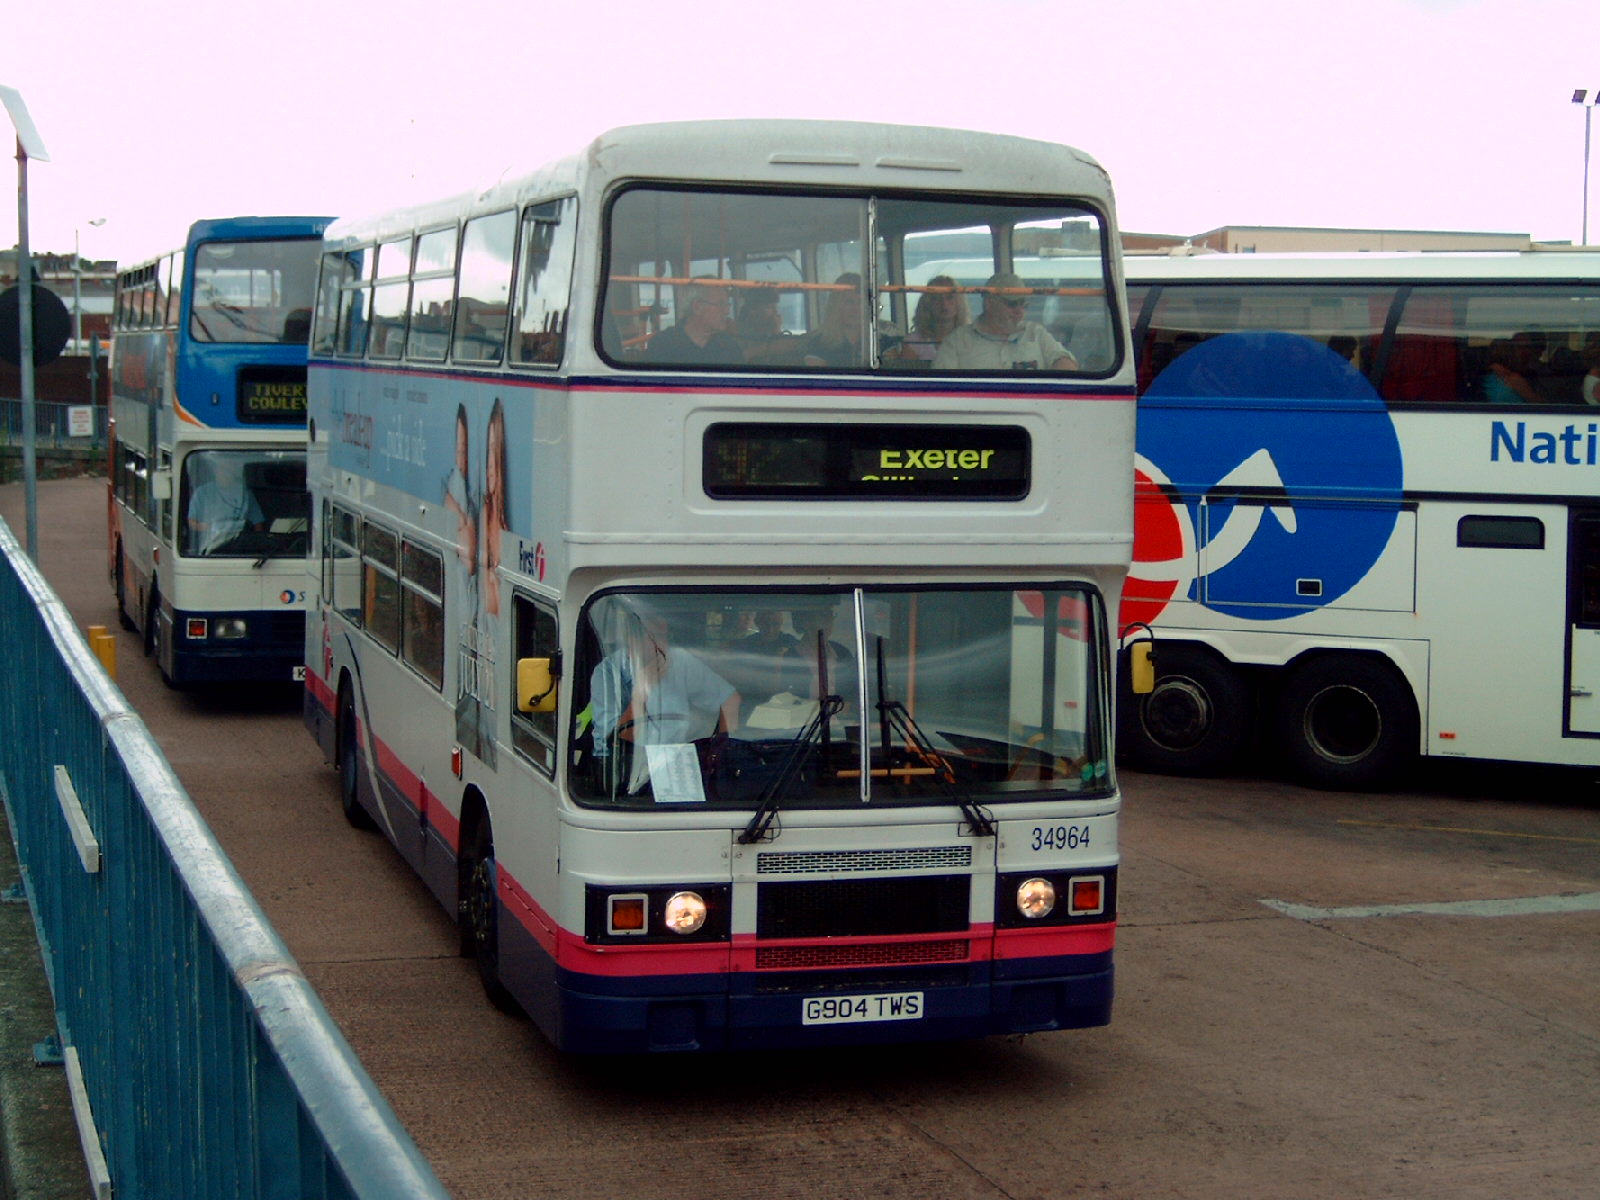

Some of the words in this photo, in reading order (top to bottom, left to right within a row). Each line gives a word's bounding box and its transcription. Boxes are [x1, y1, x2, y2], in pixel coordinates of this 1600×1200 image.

[255, 384, 307, 397] TIVER
[1490, 420, 1598, 466] Nati
[880, 449, 995, 470] Exeter
[1031, 825, 1090, 851] 34964
[807, 998, 868, 1020] G904
[874, 995, 919, 1017] TWS
